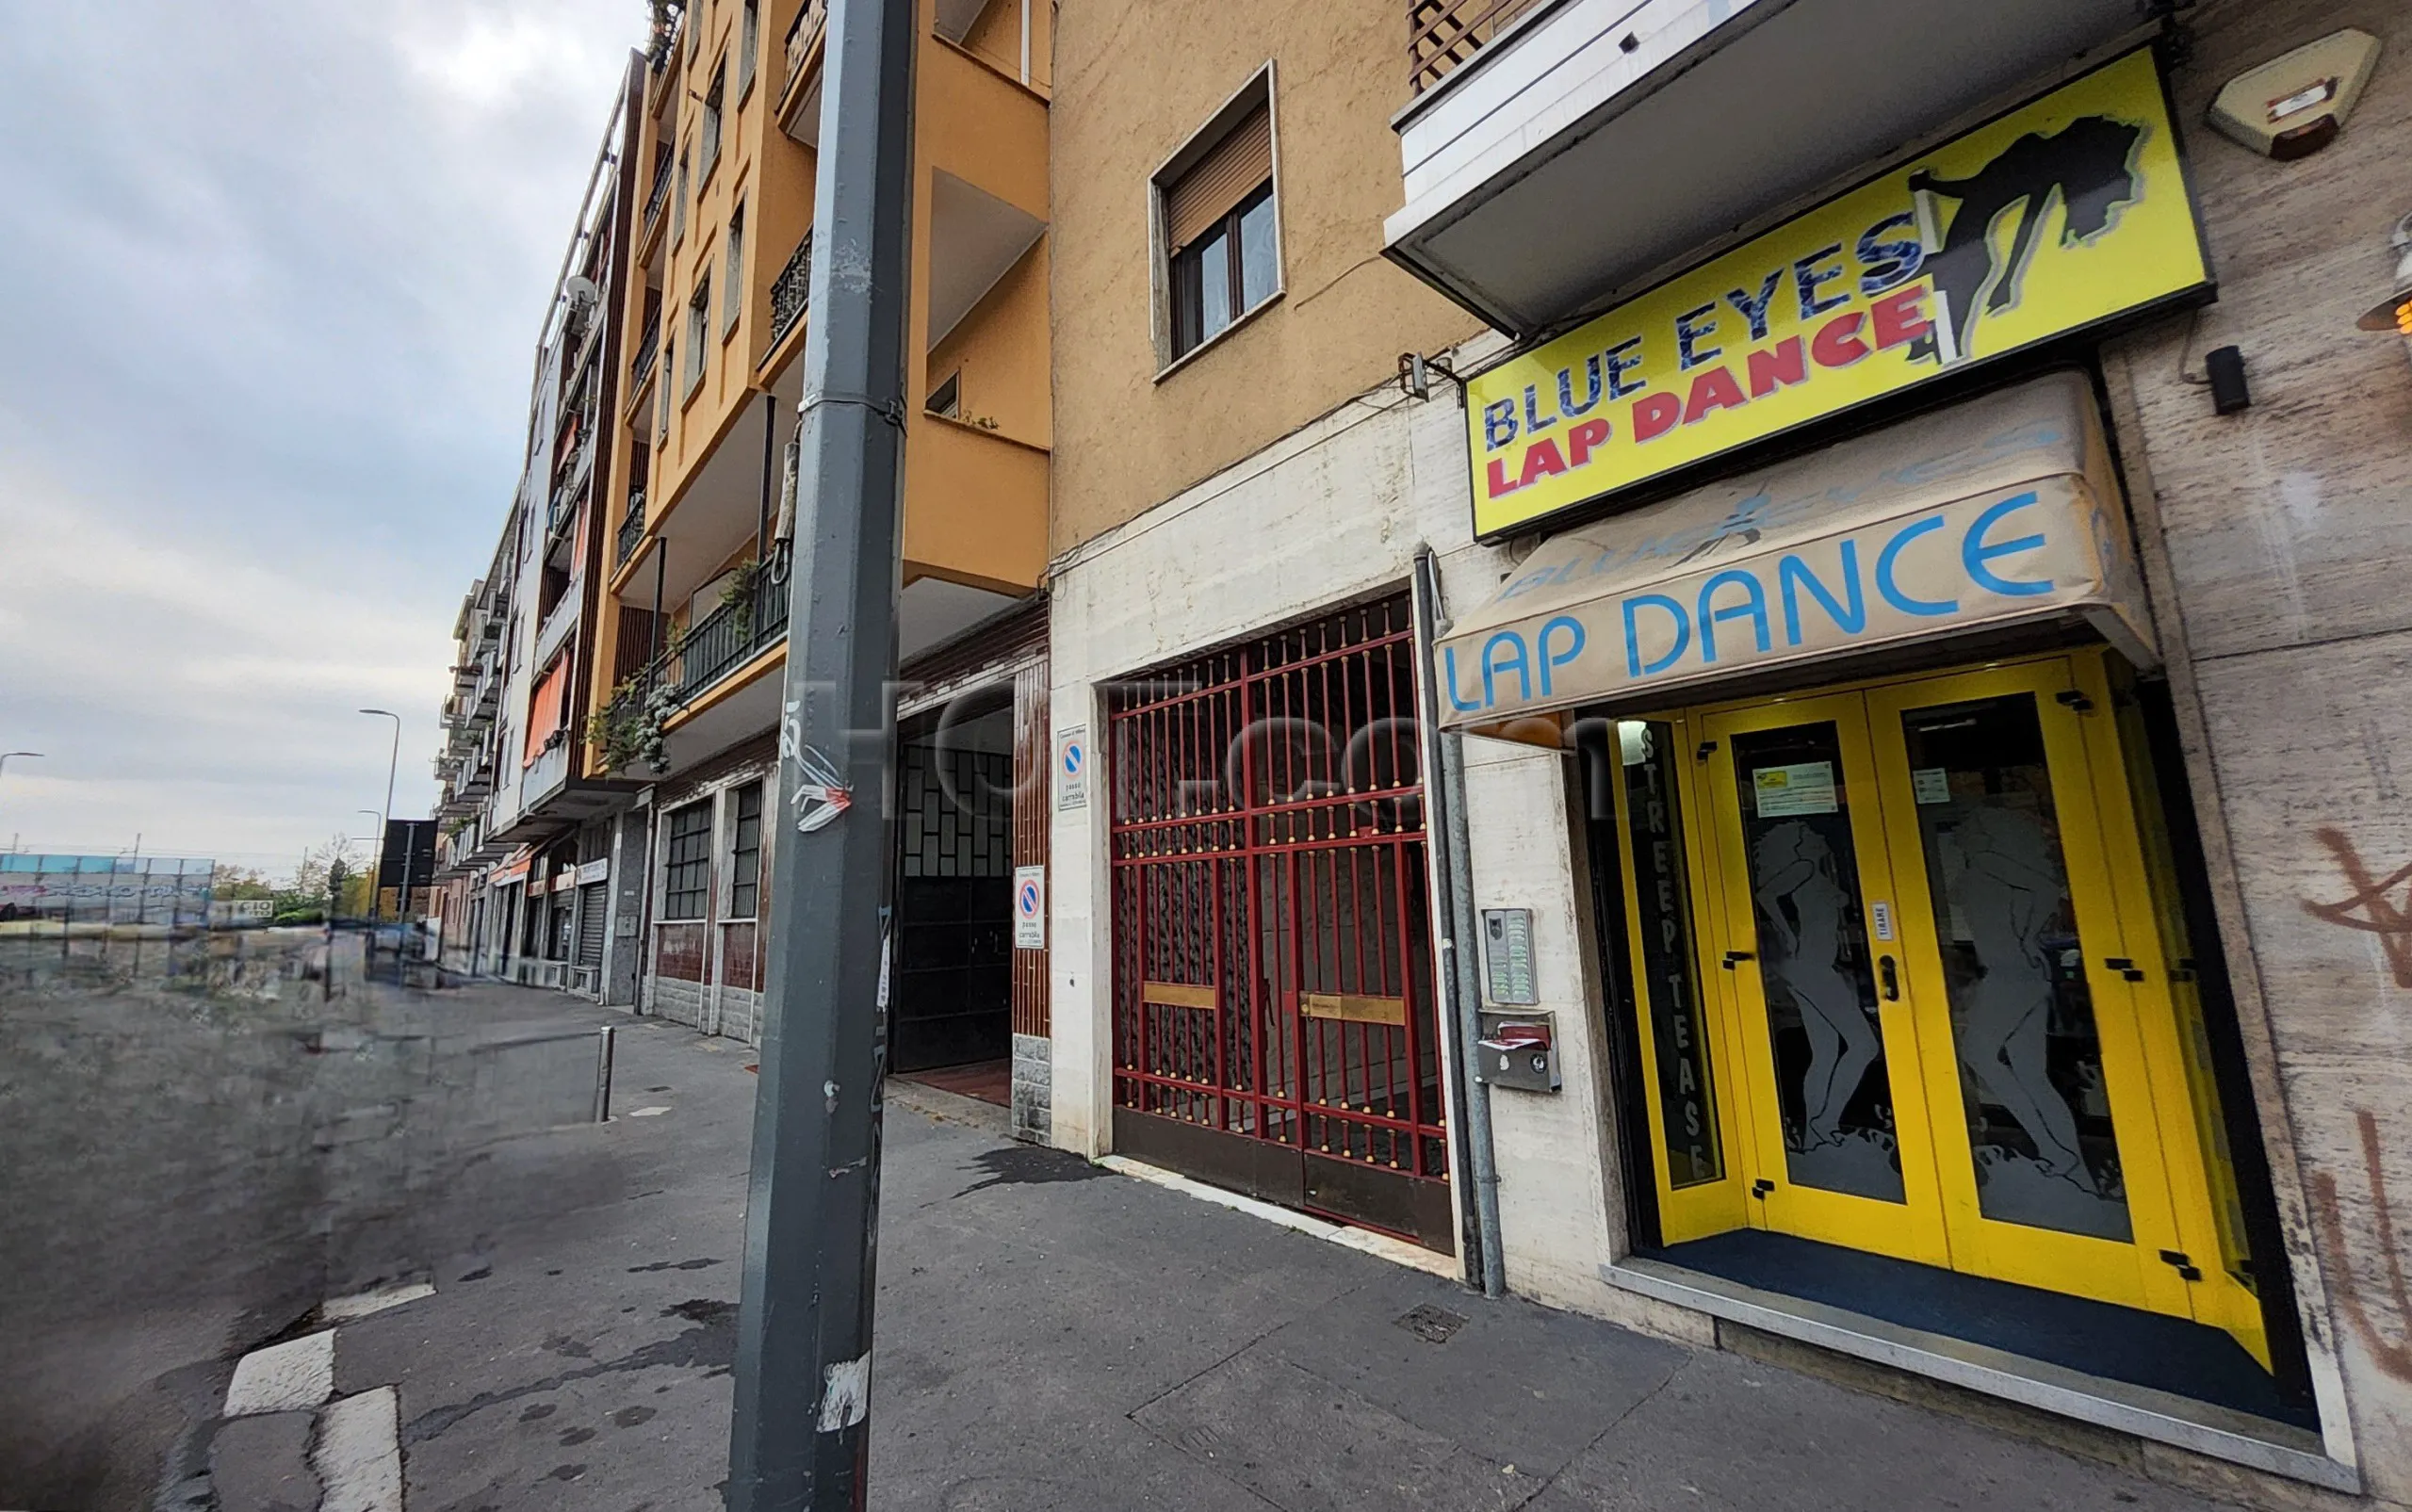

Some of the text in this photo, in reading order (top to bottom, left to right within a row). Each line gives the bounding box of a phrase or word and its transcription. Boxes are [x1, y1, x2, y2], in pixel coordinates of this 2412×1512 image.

[1484, 210, 1924, 452] BLUE EYES
[1487, 283, 1931, 500] LAP DANCE
[1444, 491, 2056, 712] LAP DANCE
[1668, 973, 1707, 1179] TEASE
